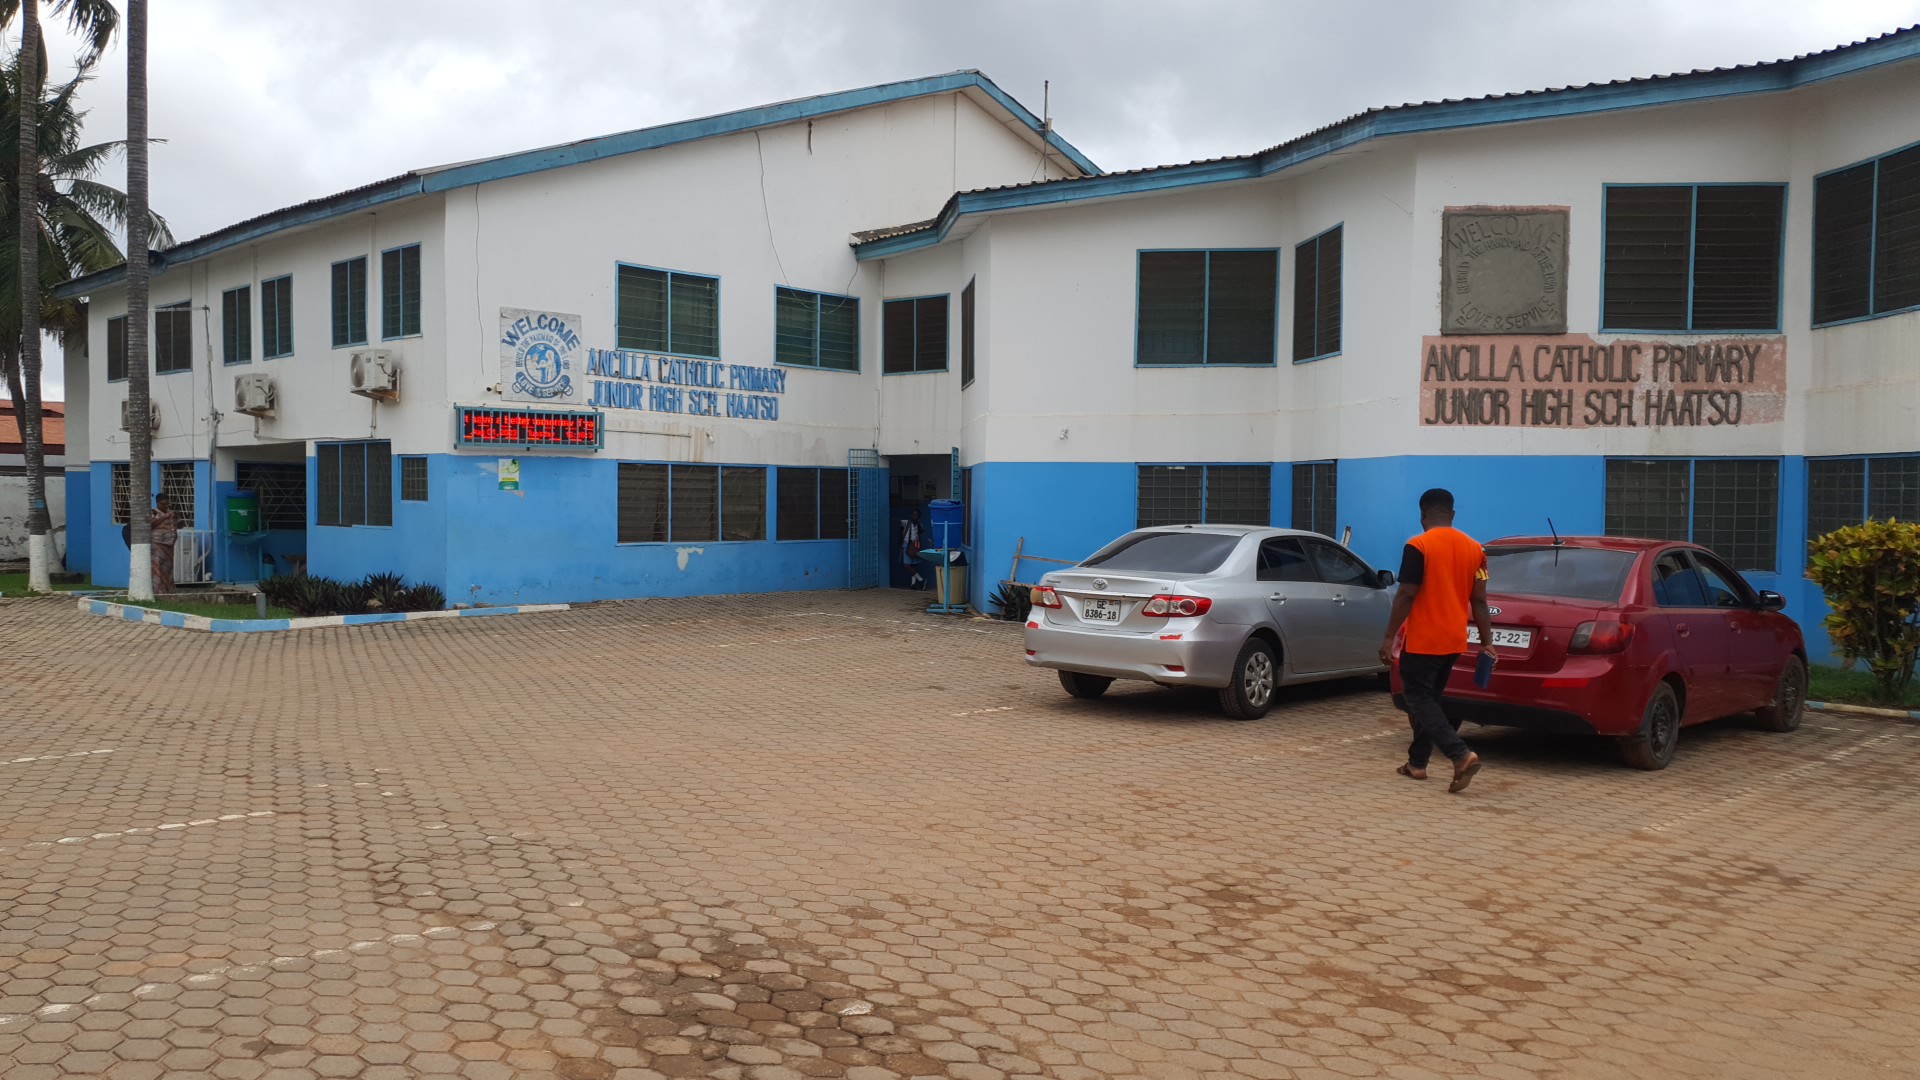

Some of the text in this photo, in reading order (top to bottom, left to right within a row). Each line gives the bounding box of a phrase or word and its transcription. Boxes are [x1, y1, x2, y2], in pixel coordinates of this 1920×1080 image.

[1447, 215, 1561, 253] WELCOME
[501, 313, 581, 351] WELCOME
[1460, 301, 1492, 328] LOVE
[587, 348, 787, 394] ANCILLA CATHOLIC PRIMARY
[1424, 344, 1763, 382] ANCILLA CATHOLIC PRIMARY
[519, 376, 535, 394] LOVE
[587, 380, 643, 411] JUNIOR
[649, 385, 684, 414] HIGH
[726, 392, 779, 421] HAATSO
[1425, 389, 1510, 426] JUNIOR
[1521, 389, 1573, 425] HIGH
[1644, 389, 1743, 426] HAATSO
[1085, 609, 1117, 620] 8386-18
[1096, 600, 1107, 609] GE
